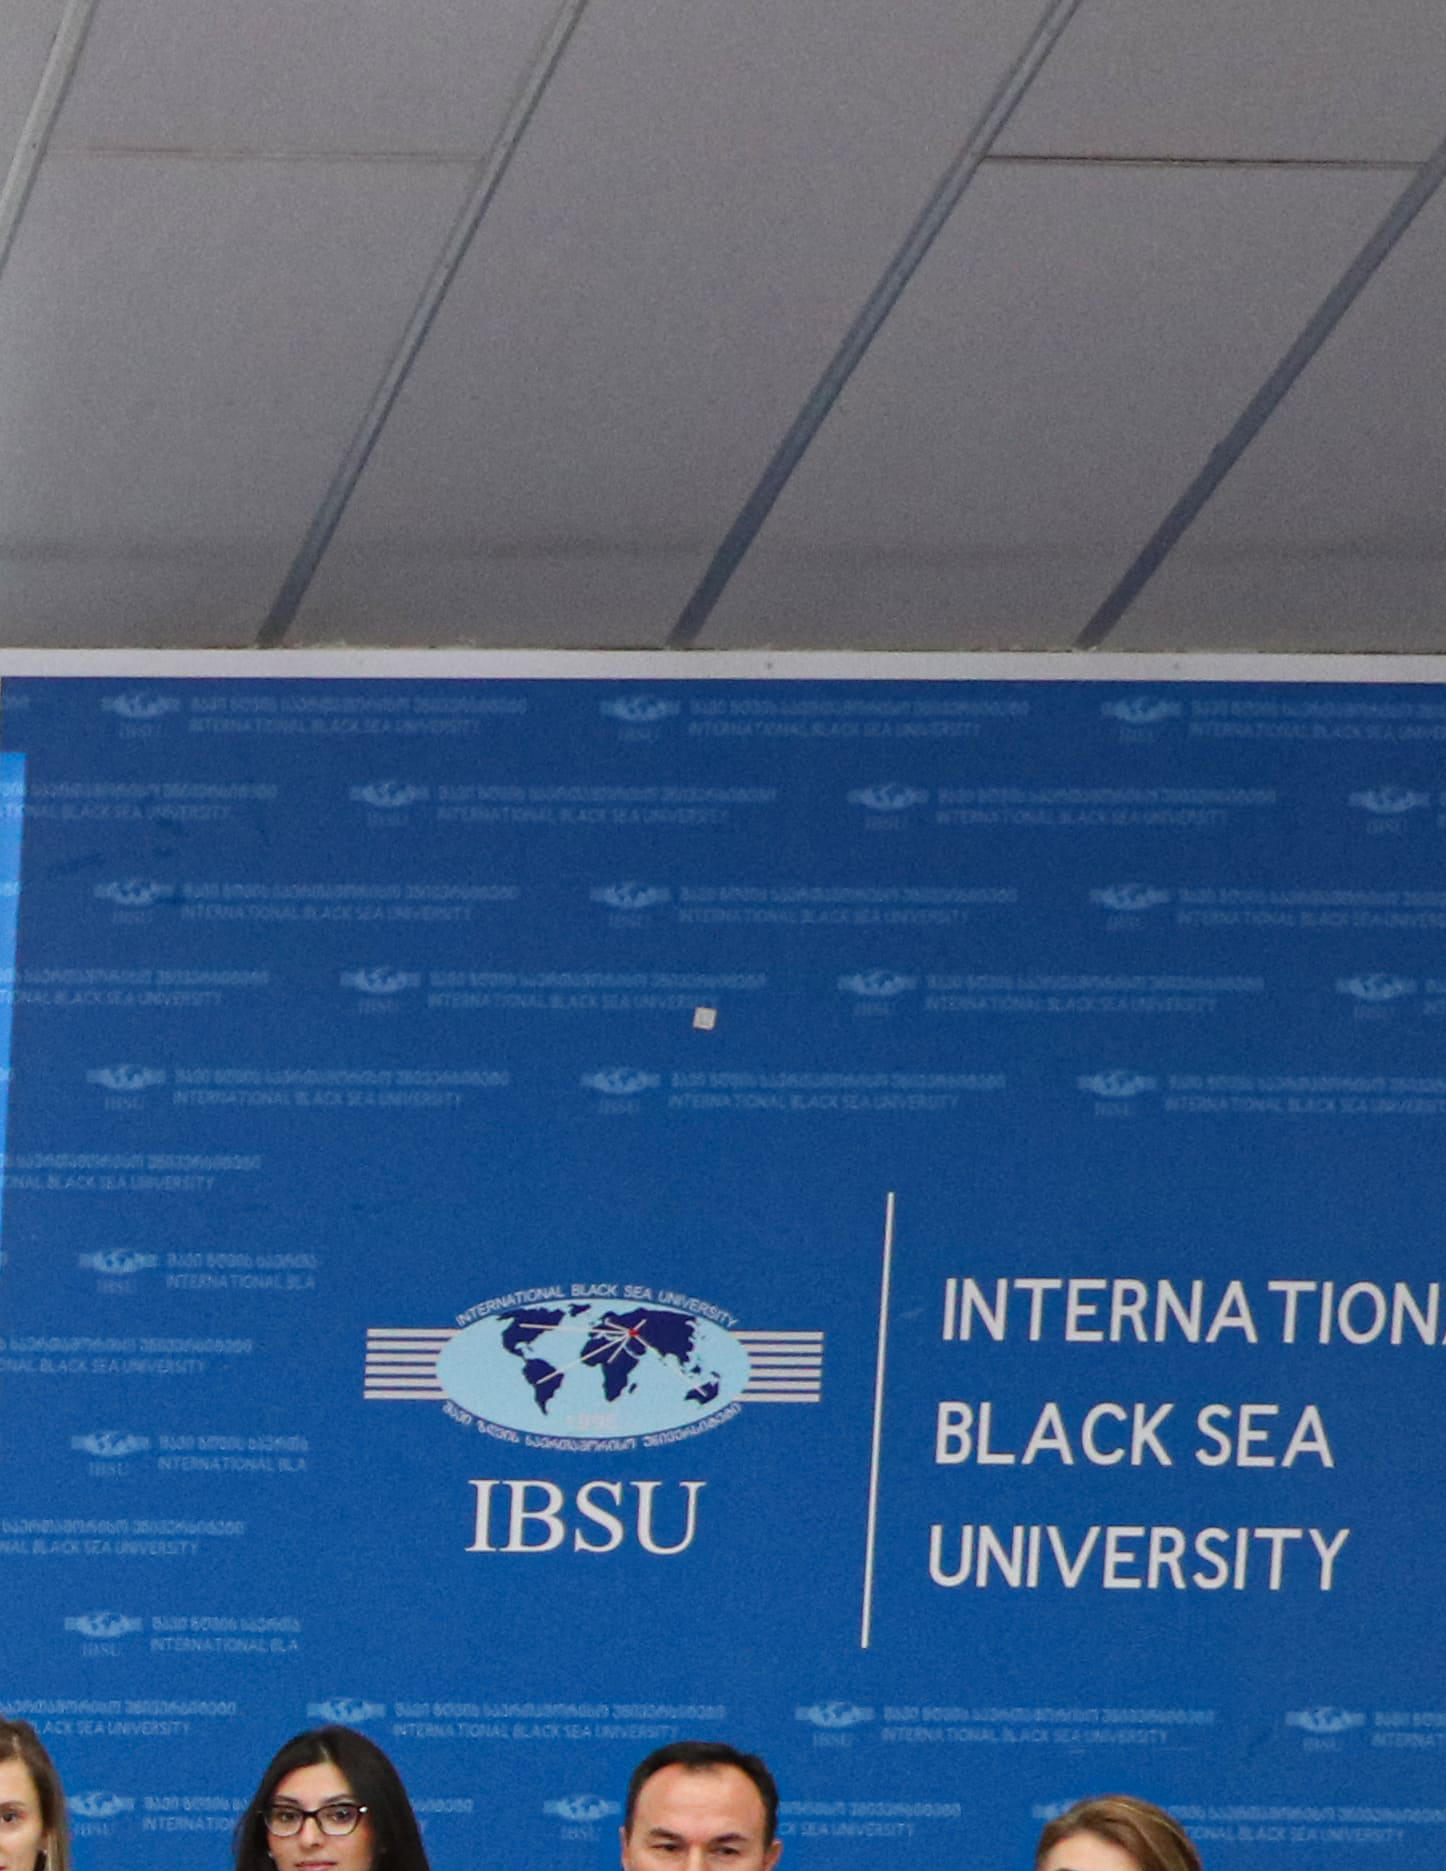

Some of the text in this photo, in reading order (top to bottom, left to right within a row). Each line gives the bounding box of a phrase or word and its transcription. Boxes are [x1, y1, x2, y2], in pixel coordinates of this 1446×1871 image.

[455, 1283, 740, 1328] INTERNATIONAL BLACK SEA UNIVERSITY
[942, 1277, 1446, 1345] INTERNATION
[935, 1401, 1335, 1469] BLACK SEA
[464, 1479, 708, 1556] IBSU
[928, 1523, 1351, 1592] UNIVERSITY
[393, 1724, 507, 1738] INTERNATIONAL
[596, 1725, 679, 1739] UNIVERSITY
[882, 1728, 996, 1742] INTERNATIONAL
[1084, 1729, 1167, 1743] UNIVERSITY
